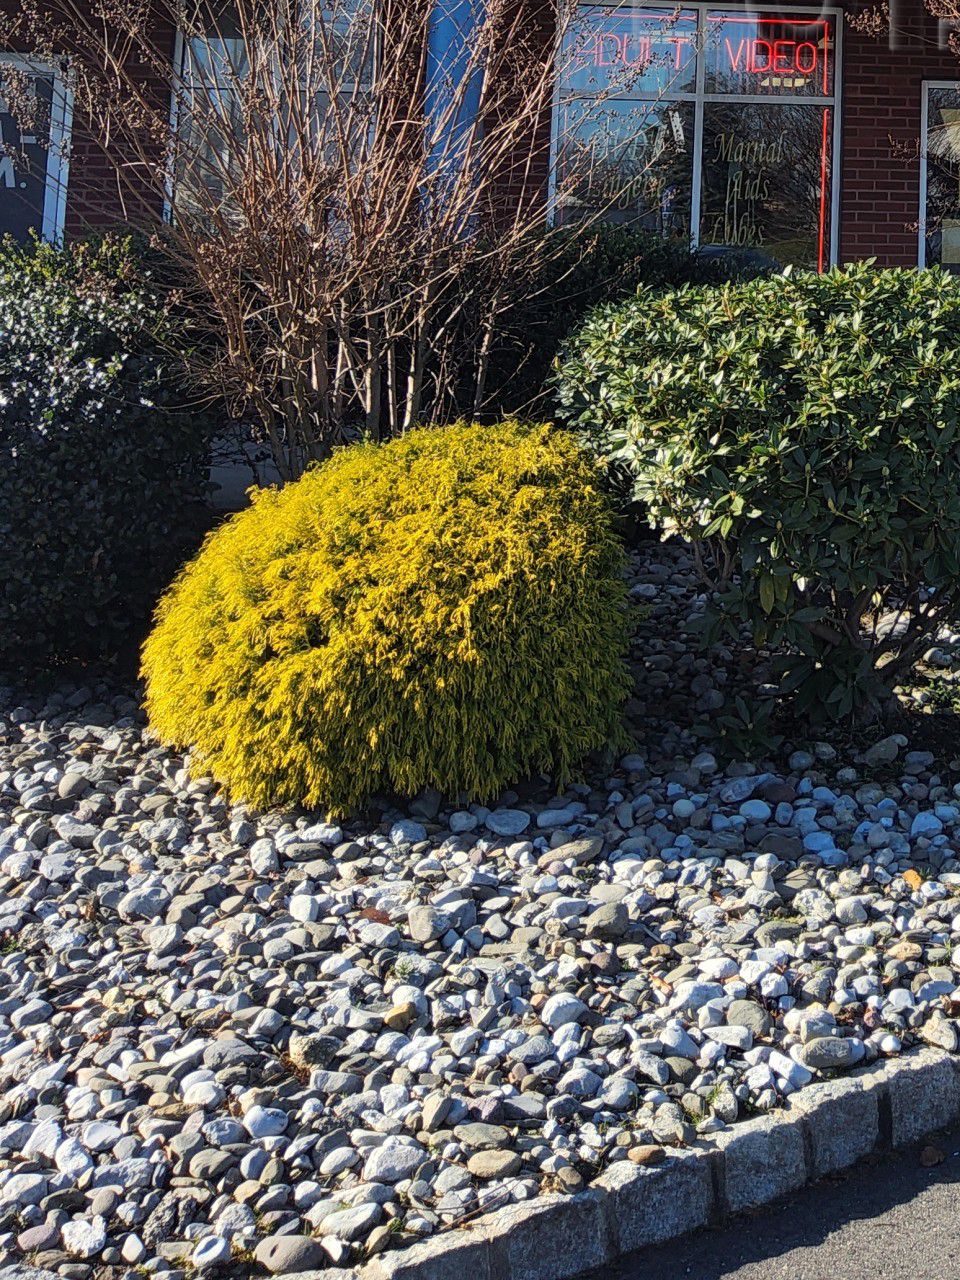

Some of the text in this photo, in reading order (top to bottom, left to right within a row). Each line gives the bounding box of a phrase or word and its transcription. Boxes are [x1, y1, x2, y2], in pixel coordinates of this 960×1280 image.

[725, 38, 818, 73] VIDEO
[711, 129, 788, 163] Marital
[585, 166, 667, 211] ingere
[727, 166, 771, 201] Aids
